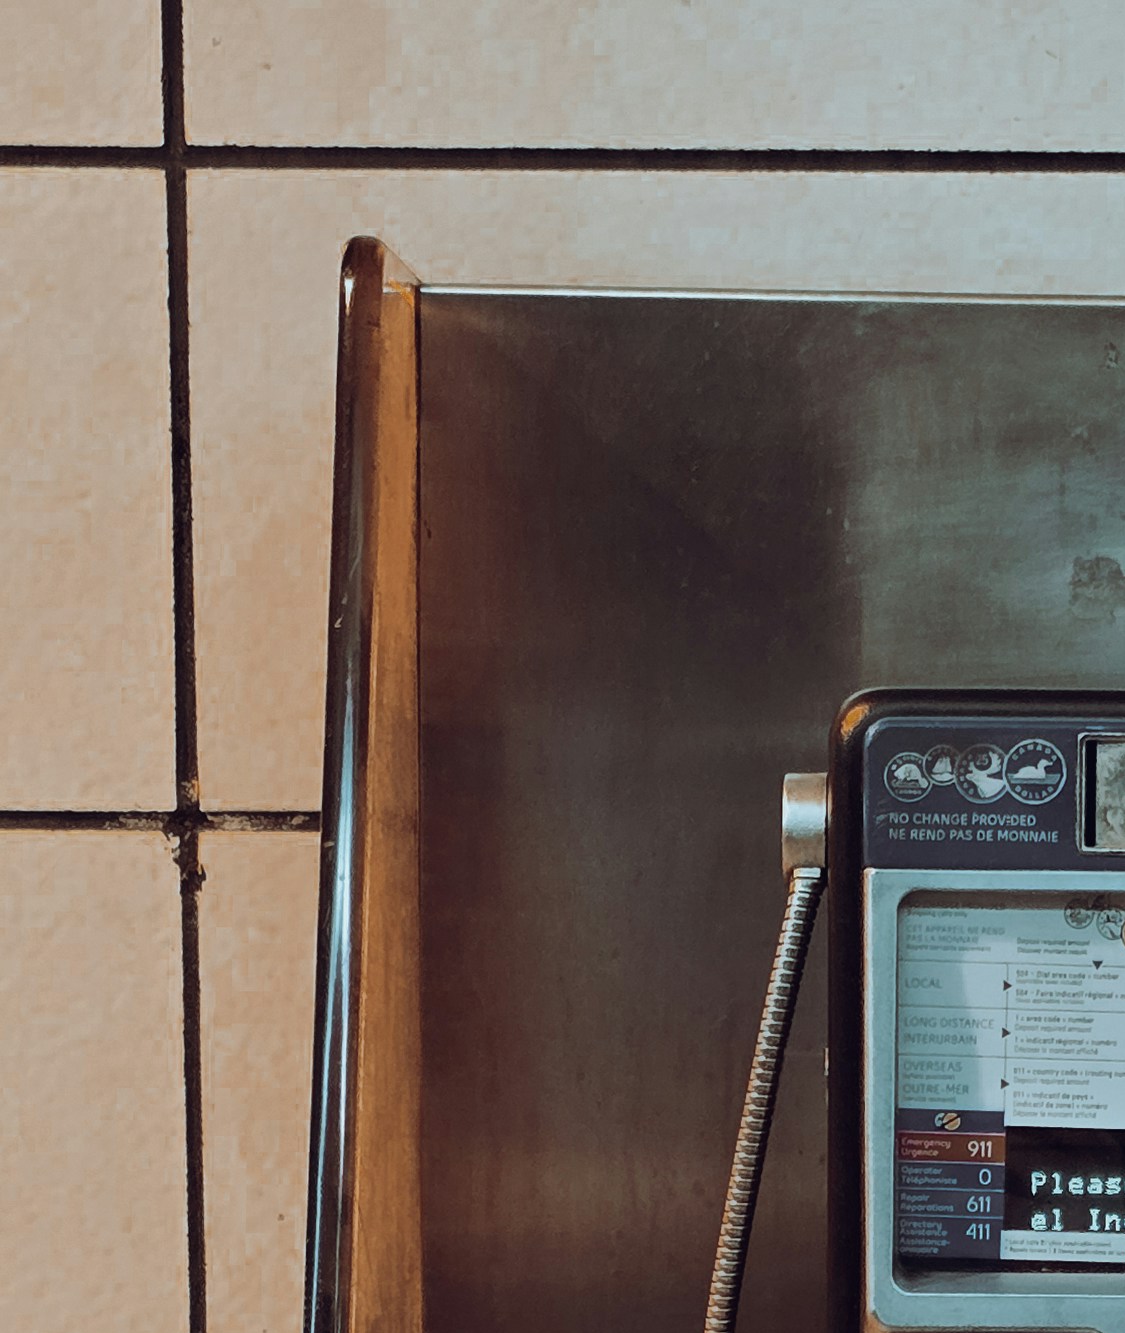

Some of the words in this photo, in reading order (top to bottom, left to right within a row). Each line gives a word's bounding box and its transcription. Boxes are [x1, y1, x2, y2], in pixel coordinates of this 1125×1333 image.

[888, 812, 909, 825] NO
[912, 812, 968, 826] CHANGE
[888, 828, 906, 841] NE
[910, 828, 946, 841] REND
[950, 828, 973, 841] PAS
[976, 829, 994, 842] DE
[997, 829, 1059, 843] MONNAIE
[904, 977, 943, 990] LOCAL
[904, 1016, 938, 1029] LONG
[940, 1017, 995, 1030] DISTANCE
[903, 1032, 978, 1046] INTERURBAIN
[903, 1060, 963, 1073] OVERSEAS
[901, 1138, 951, 1150] Emergency
[967, 1140, 992, 1158] 911
[901, 1149, 939, 1158] Urgence
[901, 1165, 943, 1176] Operator
[978, 1168, 992, 1185] 0
[966, 1195, 991, 1213] 611
[1030, 1207, 1063, 1232] el
[965, 1223, 991, 1241] 411
